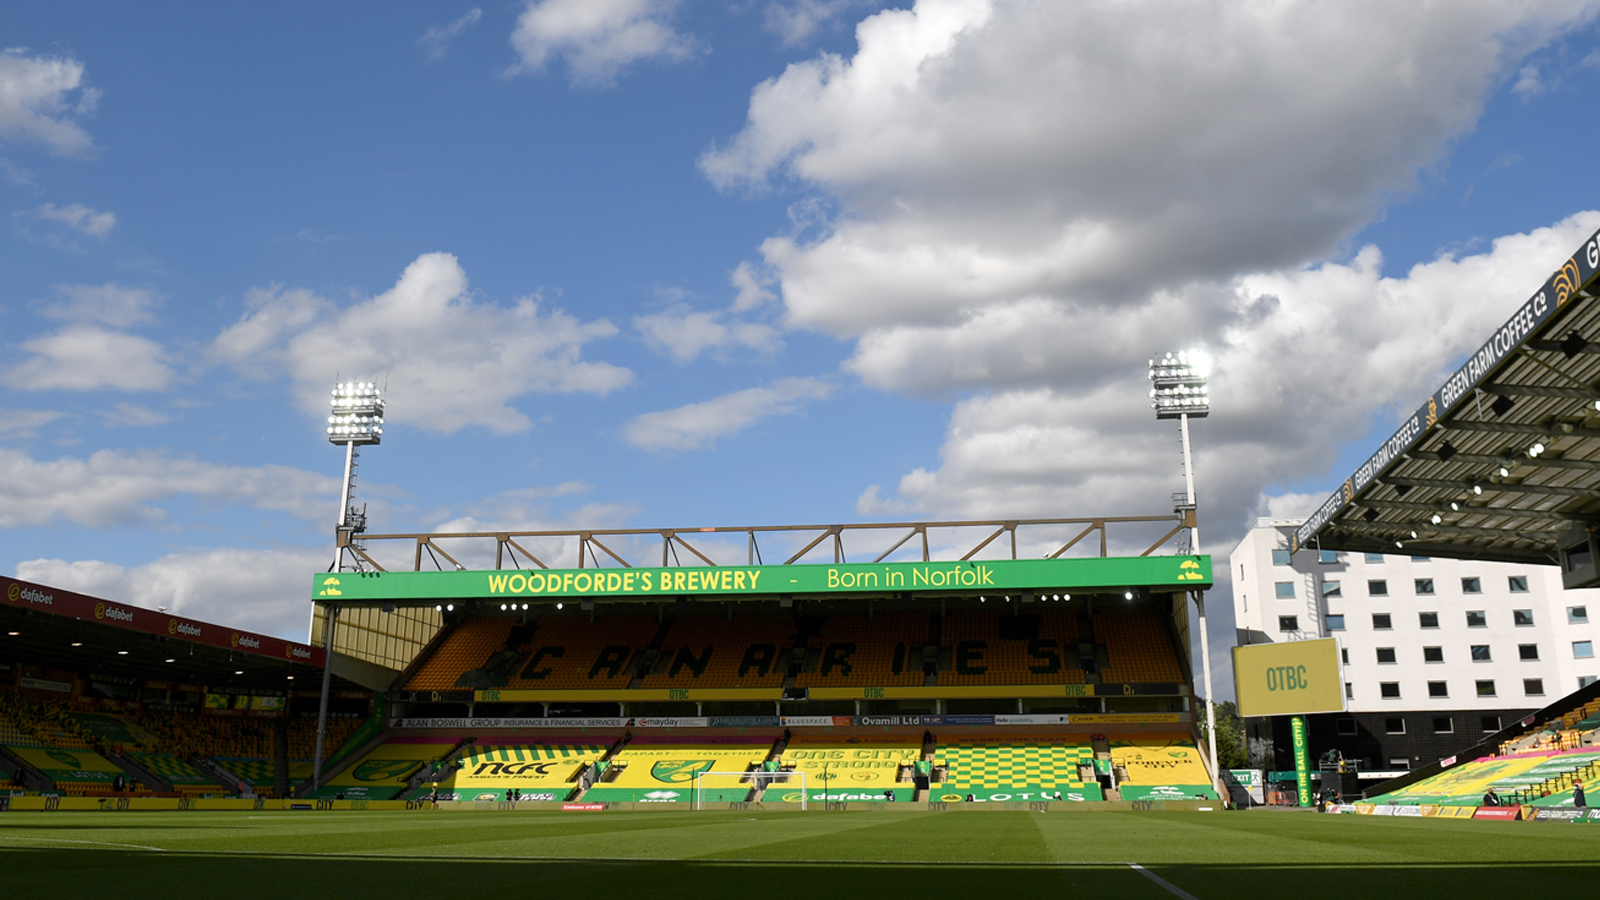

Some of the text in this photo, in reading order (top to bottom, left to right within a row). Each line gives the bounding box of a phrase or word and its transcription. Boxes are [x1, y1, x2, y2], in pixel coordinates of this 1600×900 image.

[1441, 368, 1469, 409] GREEN
[1469, 342, 1496, 383] FARM
[1494, 303, 1535, 357] COFFEE
[1354, 465, 1374, 490] GREEN
[1371, 445, 1389, 476] FARM
[1388, 423, 1413, 459] COFFEE
[488, 571, 653, 593] WOODFORDE'S
[660, 569, 761, 591] BREWERY
[827, 568, 878, 587] Born
[885, 567, 905, 586] in
[912, 564, 994, 586] Norfolk
[20, 587, 54, 605] dafabet
[105, 605, 133, 622] dafabet
[177, 622, 201, 637] dafabet
[238, 634, 261, 648] dafabet
[292, 645, 311, 659] dafabet
[1266, 665, 1308, 691] OTBC
[481, 690, 501, 701] OTBC
[669, 689, 689, 700] OTBC
[864, 687, 884, 698] OTBC
[1065, 685, 1086, 696] OTBC
[406, 719, 429, 728] ALAN
[431, 719, 470, 728] BOSWELL
[471, 719, 501, 728] GROUP
[586, 719, 621, 727] SERVICES
[647, 717, 679, 727] mayday
[862, 716, 900, 725] Ovamill
[903, 716, 919, 725] Ltd
[789, 750, 915, 760] ONE CITY
[1295, 749, 1306, 770] BALL
[803, 760, 897, 769] STRONG
[1234, 774, 1250, 782] EXIT
[1299, 770, 1307, 787] THE
[812, 792, 888, 801] dafabe
[973, 791, 1085, 802] LOTUS
[1299, 787, 1309, 804] ON
[316, 799, 334, 810] CITY
[405, 800, 424, 810] CITY
[498, 802, 517, 810] CITY
[828, 802, 848, 811] CITY
[928, 802, 947, 811] CITY
[1030, 802, 1049, 811] CITY
[1132, 801, 1152, 810] CITY
